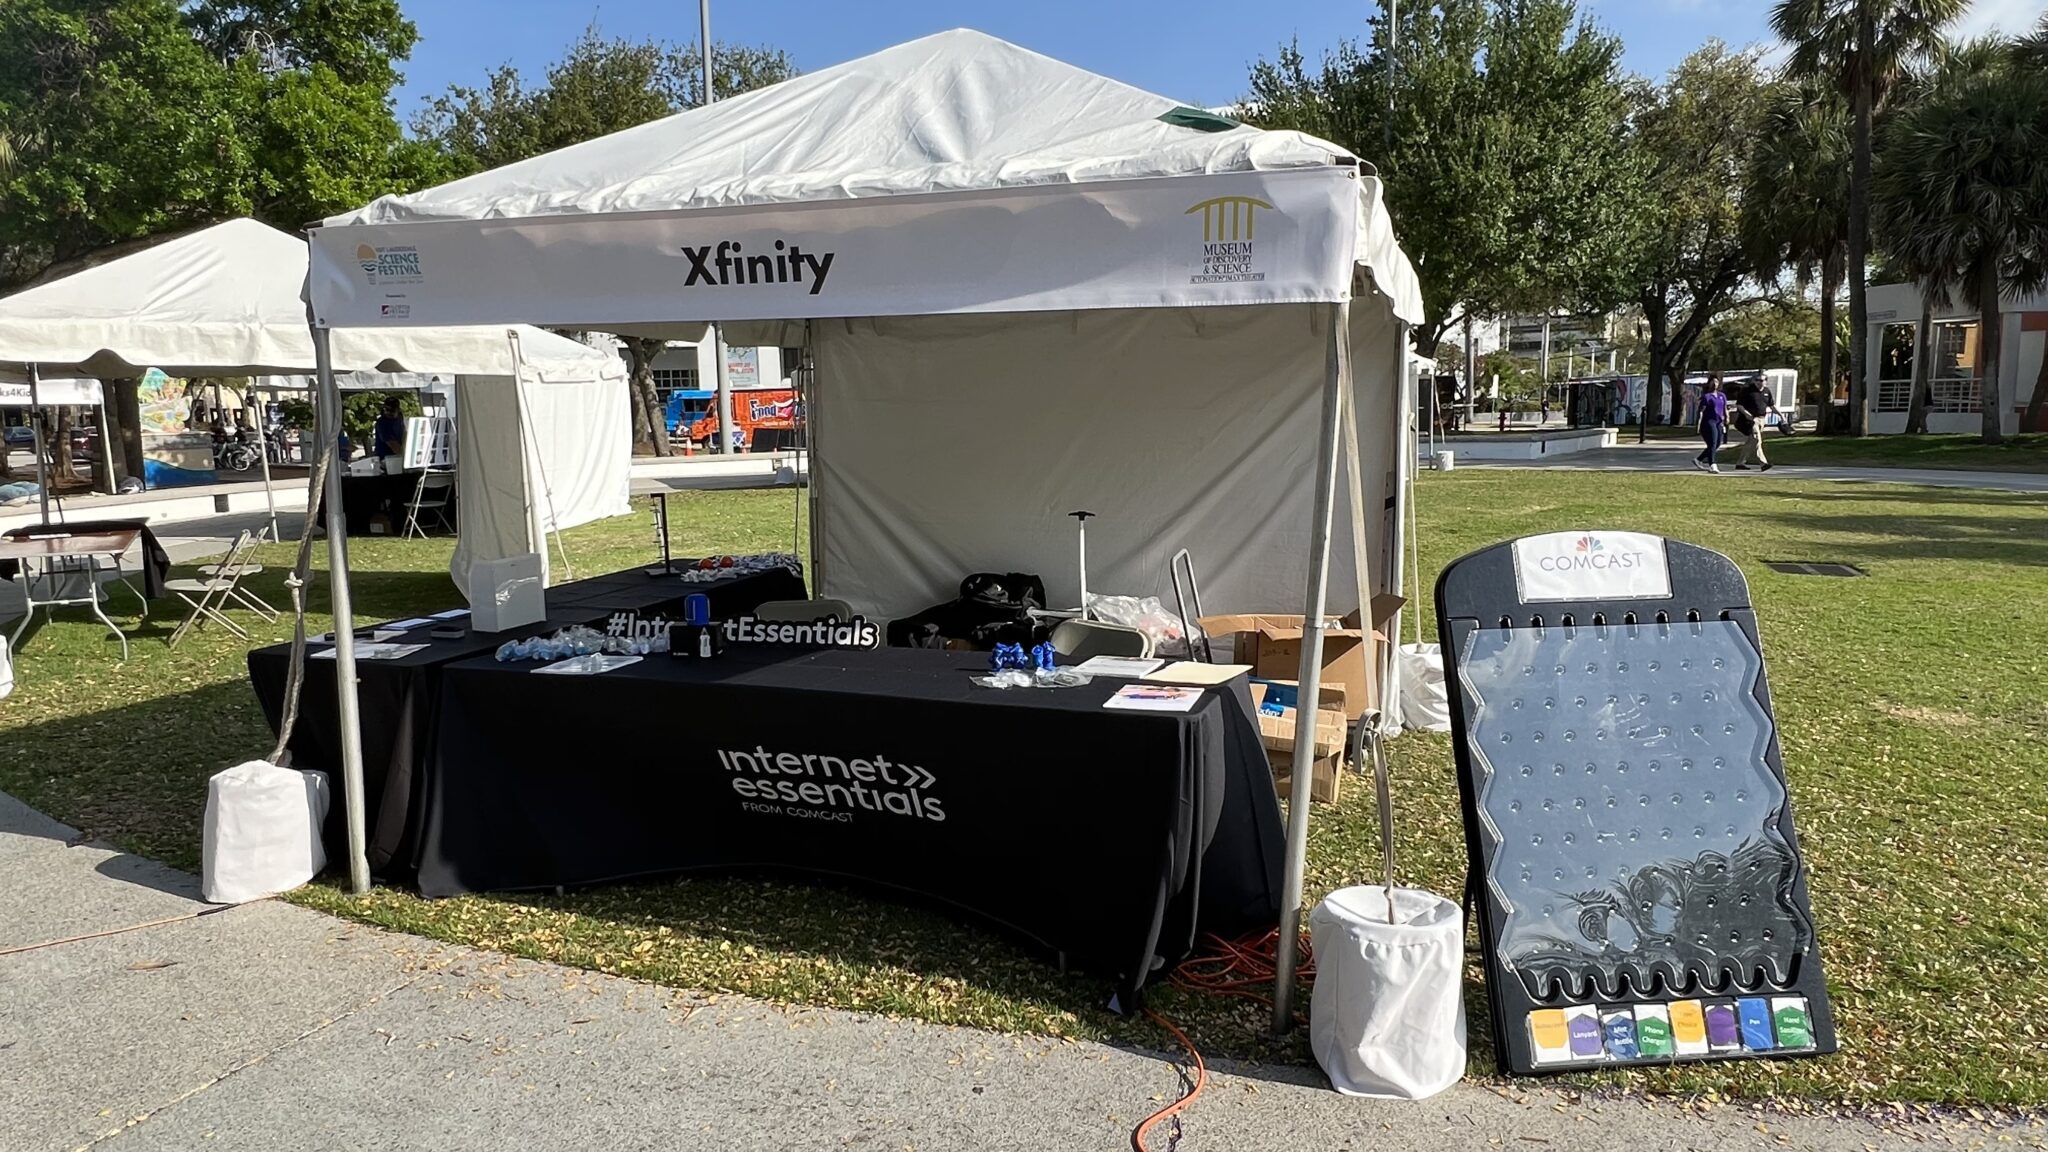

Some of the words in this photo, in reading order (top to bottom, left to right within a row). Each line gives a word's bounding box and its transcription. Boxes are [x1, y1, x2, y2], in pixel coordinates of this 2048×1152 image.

[1203, 242, 1252, 256] MUSEUM
[378, 253, 419, 264] SCIENCE
[1213, 255, 1252, 263] DISCOVERY
[378, 264, 422, 275] FESTIVAL
[681, 240, 835, 295] Xfinity
[1203, 265, 1210, 274] &
[1212, 263, 1252, 274] SCIENCE
[749, 399, 777, 421] Food
[1540, 552, 1643, 571] COMCAST
[717, 746, 898, 785] internet
[732, 778, 946, 821] essentials
[742, 802, 782, 814] FROM
[787, 807, 853, 823] COMCAST
[1573, 1030, 1598, 1039] Lanyard
[1644, 1025, 1665, 1035] Phone
